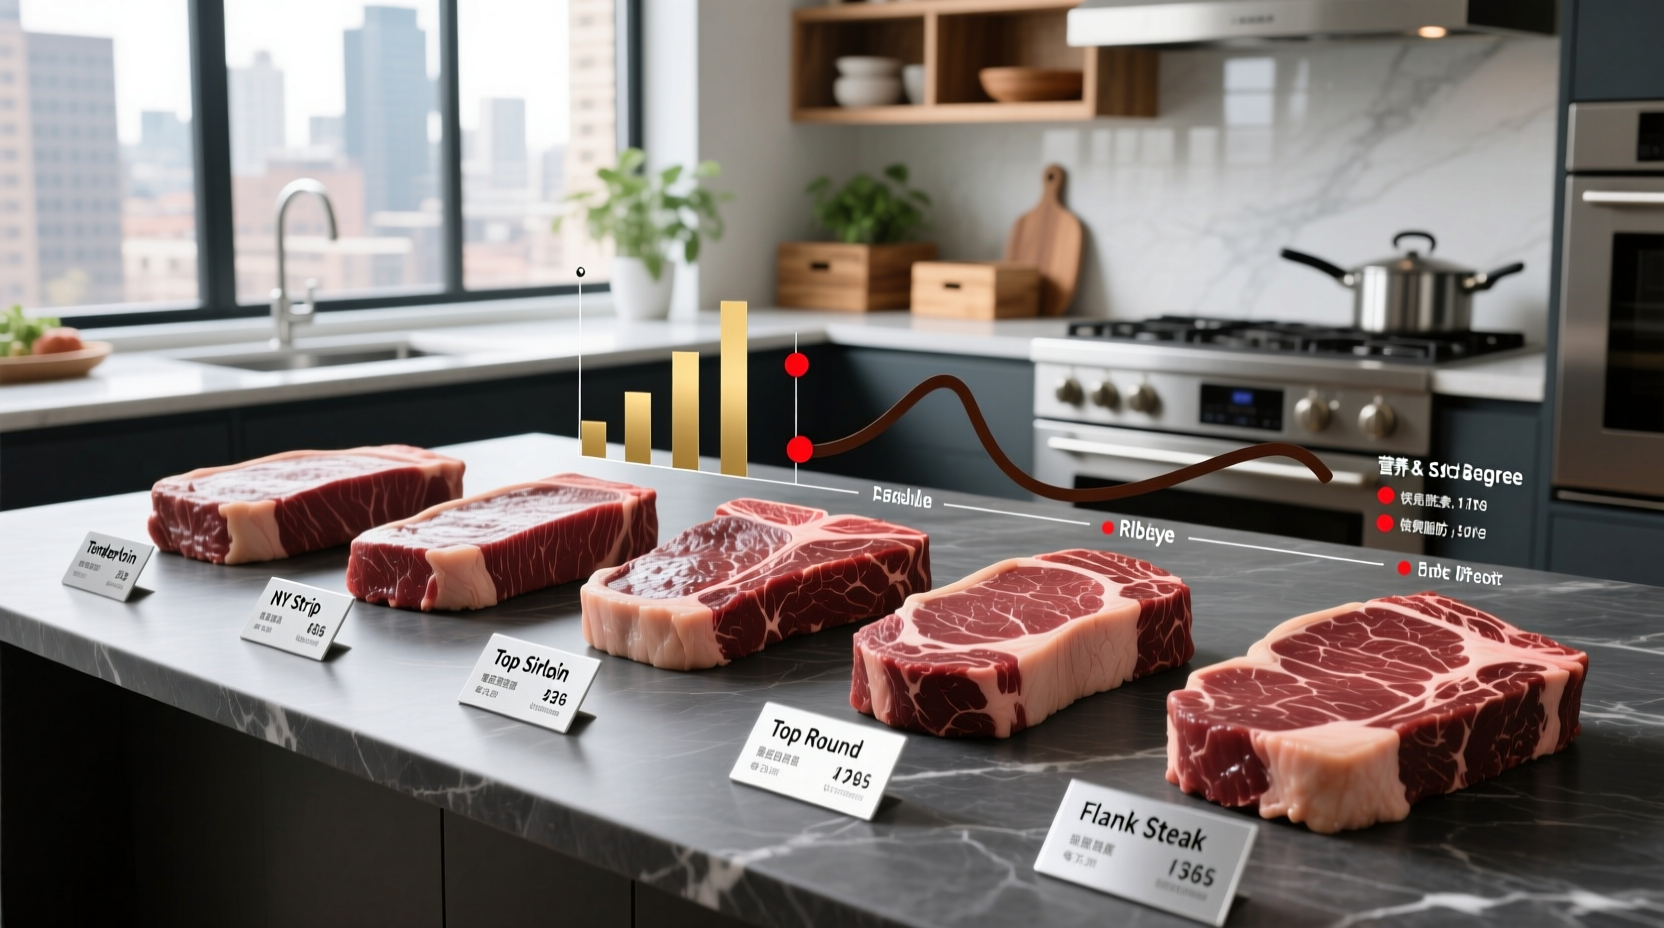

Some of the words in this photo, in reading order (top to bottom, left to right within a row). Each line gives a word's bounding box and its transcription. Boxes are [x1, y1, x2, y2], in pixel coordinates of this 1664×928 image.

[270, 590, 291, 608] NY
[290, 595, 321, 618] Strip
[494, 648, 520, 673] Top
[771, 718, 802, 747] Top
[804, 727, 865, 759] Round
[1079, 800, 1140, 835] Flank
[1142, 816, 1207, 852] Steak
